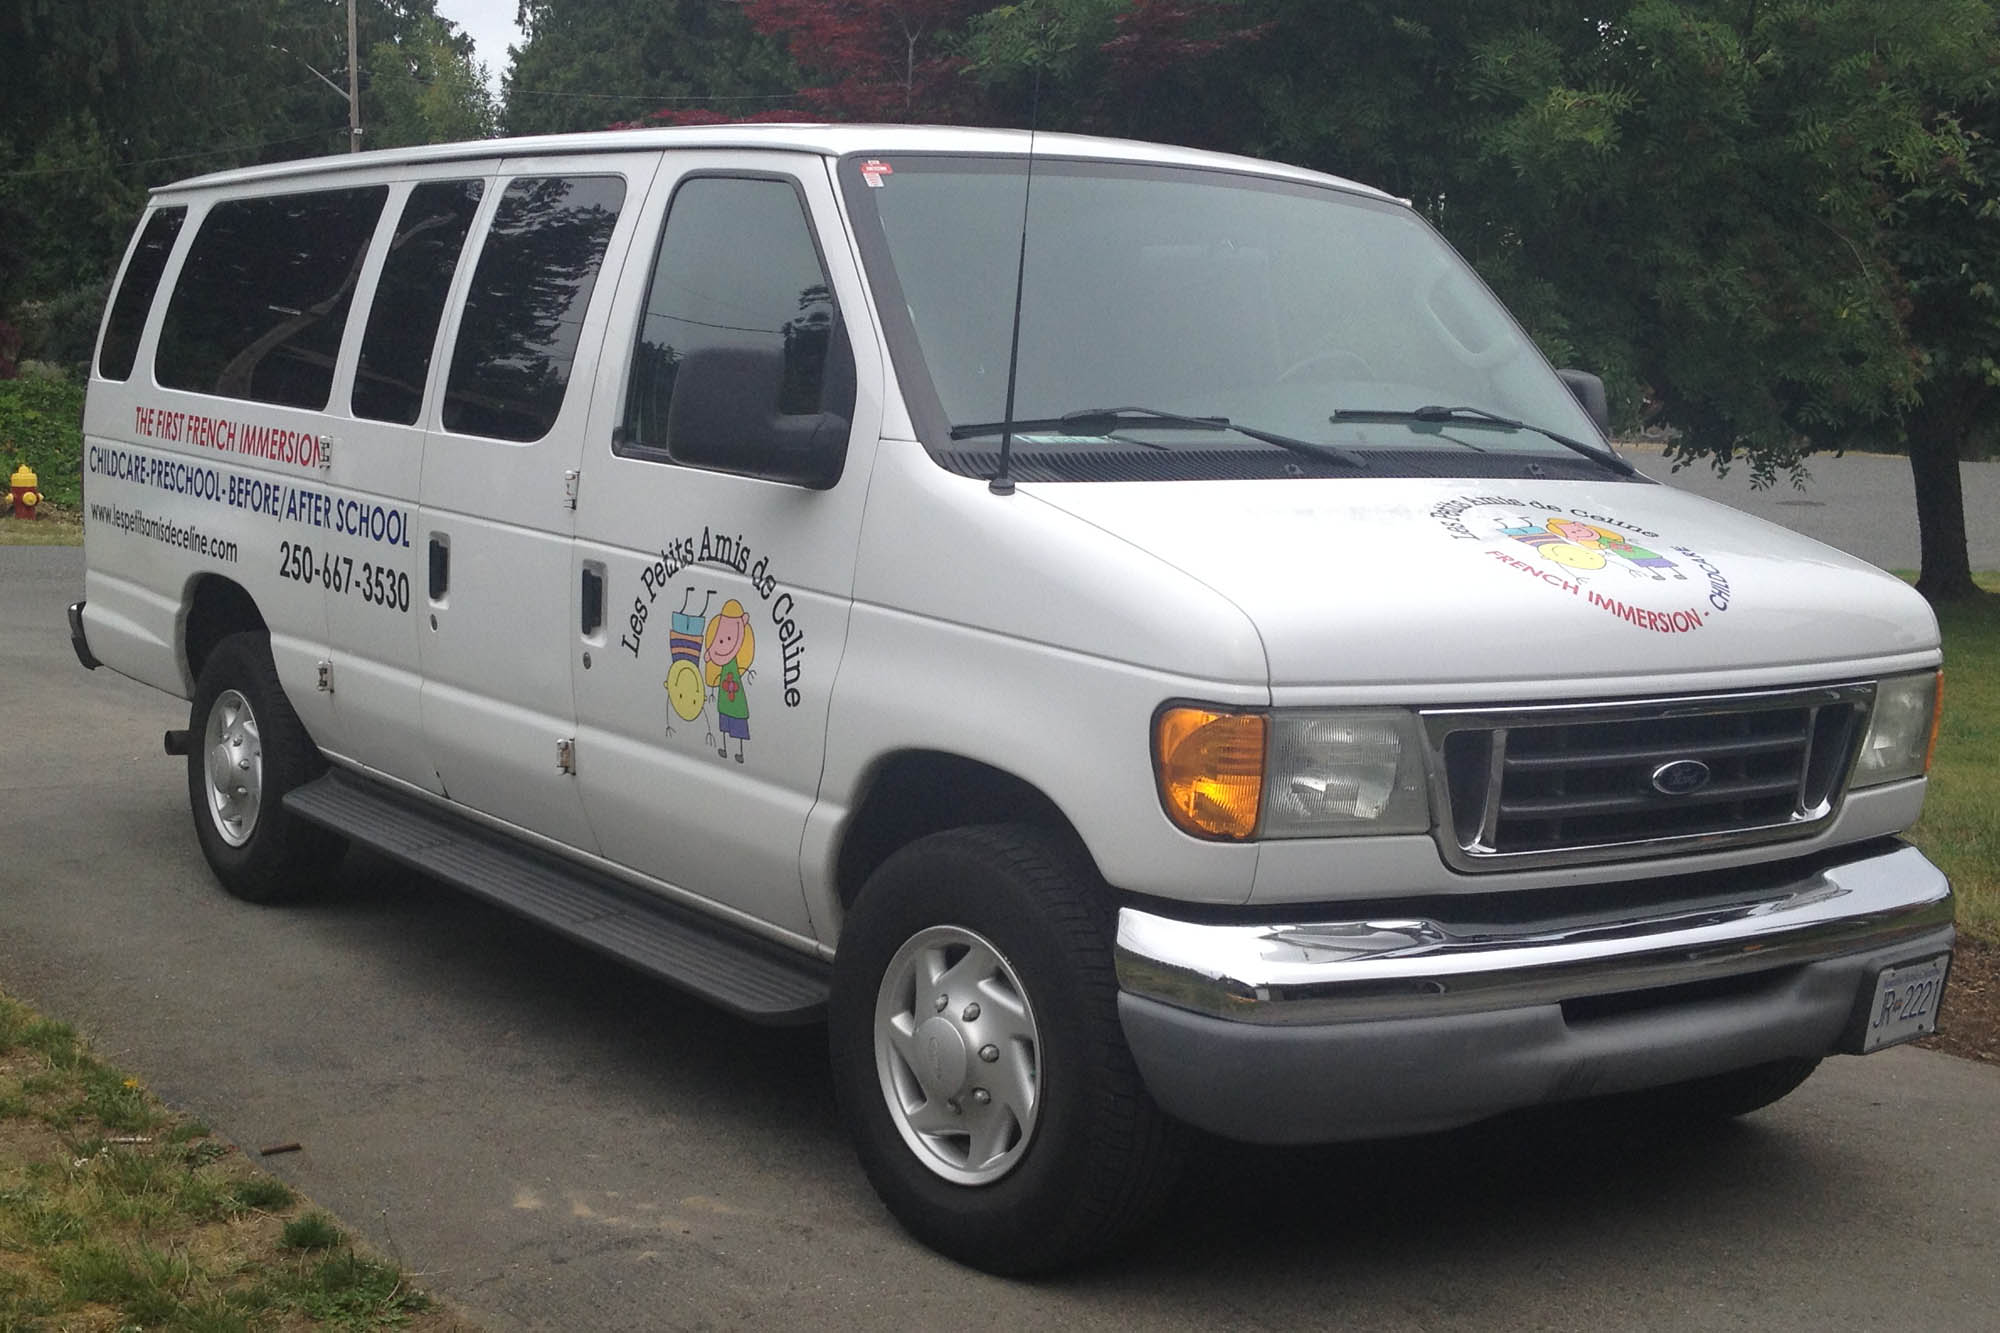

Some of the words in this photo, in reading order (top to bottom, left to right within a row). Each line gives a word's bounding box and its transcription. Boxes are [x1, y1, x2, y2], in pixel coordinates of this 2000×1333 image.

[135, 406, 154, 436] THE
[156, 409, 185, 442] FIRST
[186, 415, 237, 452] FRENCH
[239, 424, 321, 468] IMMERSION
[90, 503, 239, 563] www.lespetitsamisdeceline.com
[228, 475, 331, 529] BEFORE/AFTER
[336, 496, 411, 548] SCHOOL
[1529, 499, 1563, 513] de
[1570, 508, 1660, 538] Celine
[279, 541, 411, 613] 250-667-3530
[1485, 549, 1580, 596] FRENCH
[1587, 590, 1704, 634] IMMERSION
[621, 597, 648, 658] Les
[640, 537, 694, 603] Petits
[697, 526, 751, 574] Amis
[751, 556, 776, 599] de
[771, 592, 805, 708] Celine
